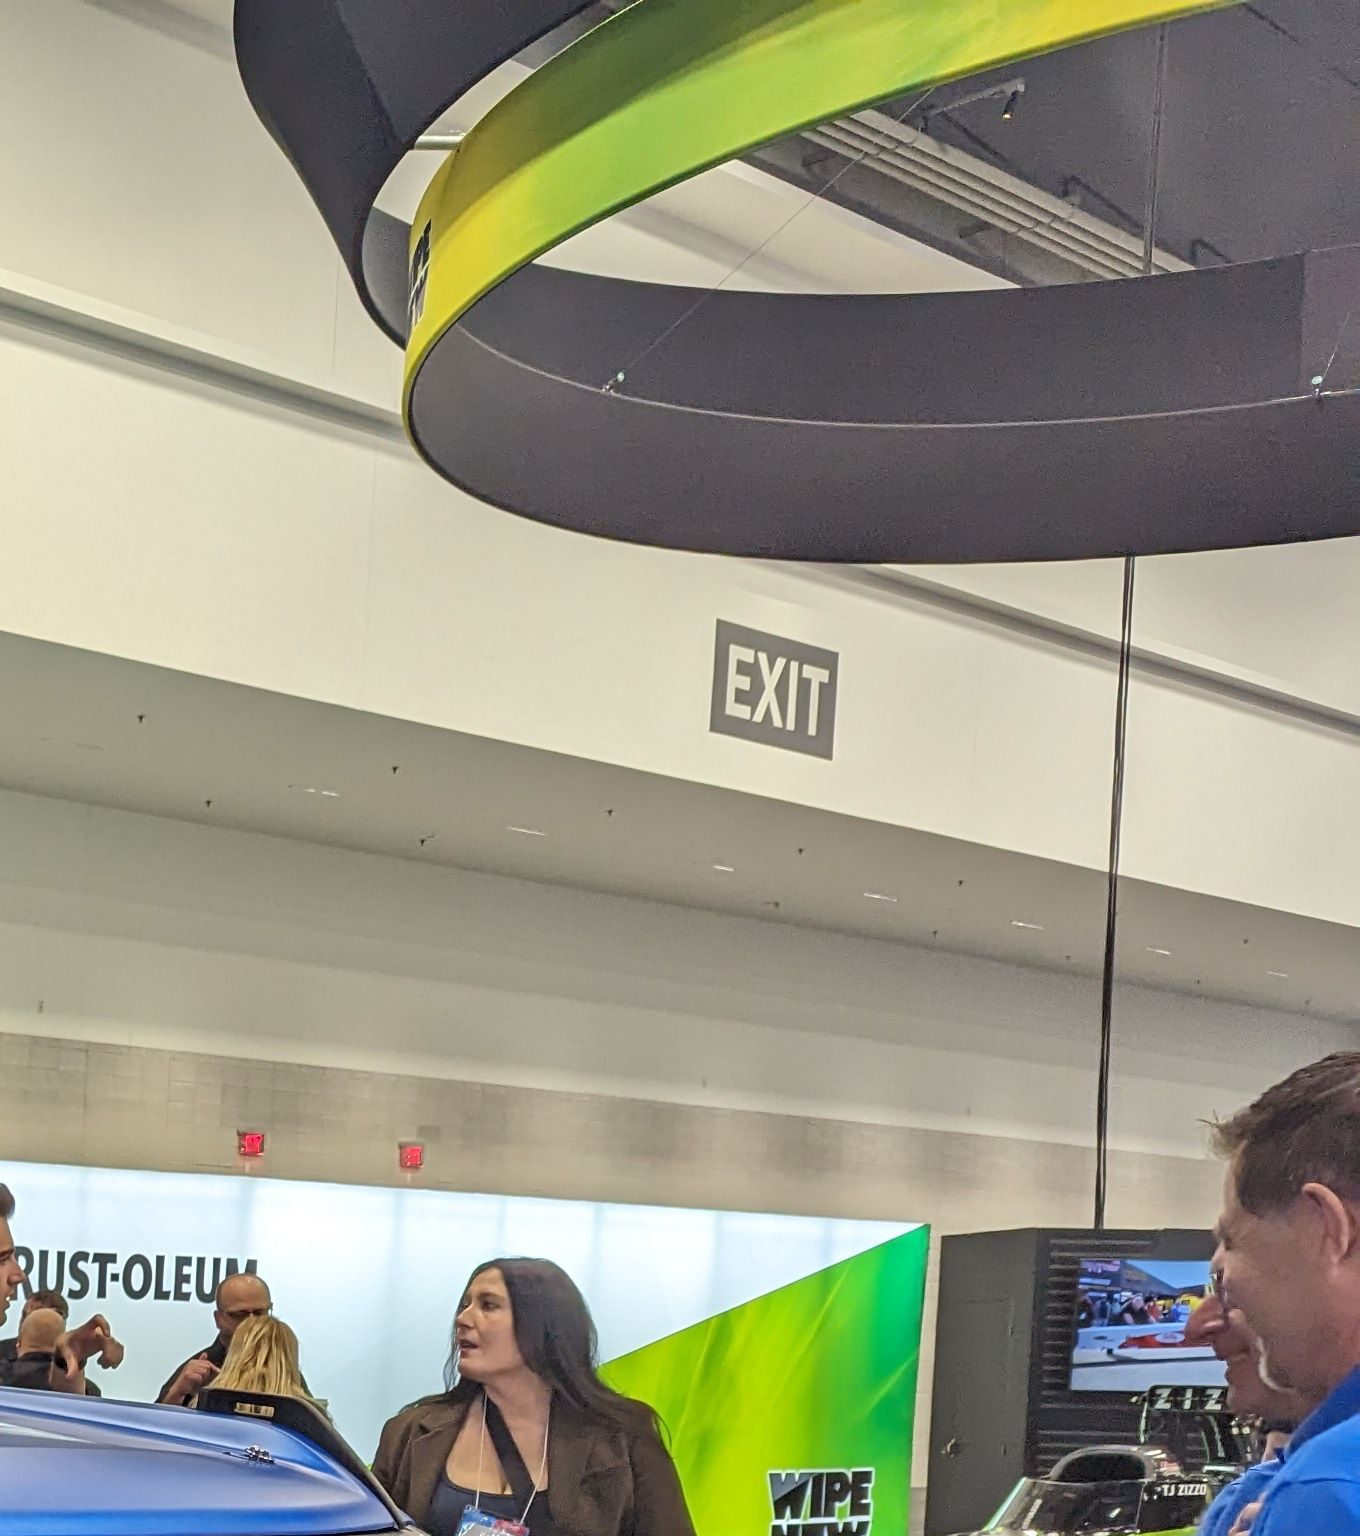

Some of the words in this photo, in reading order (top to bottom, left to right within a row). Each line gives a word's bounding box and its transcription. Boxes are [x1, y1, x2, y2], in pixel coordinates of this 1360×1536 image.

[725, 643, 830, 737] EXIT
[767, 1468, 875, 1521] WIPE
[1161, 1483, 1176, 1497] TJ
[1176, 1483, 1208, 1496] ZIZZO
